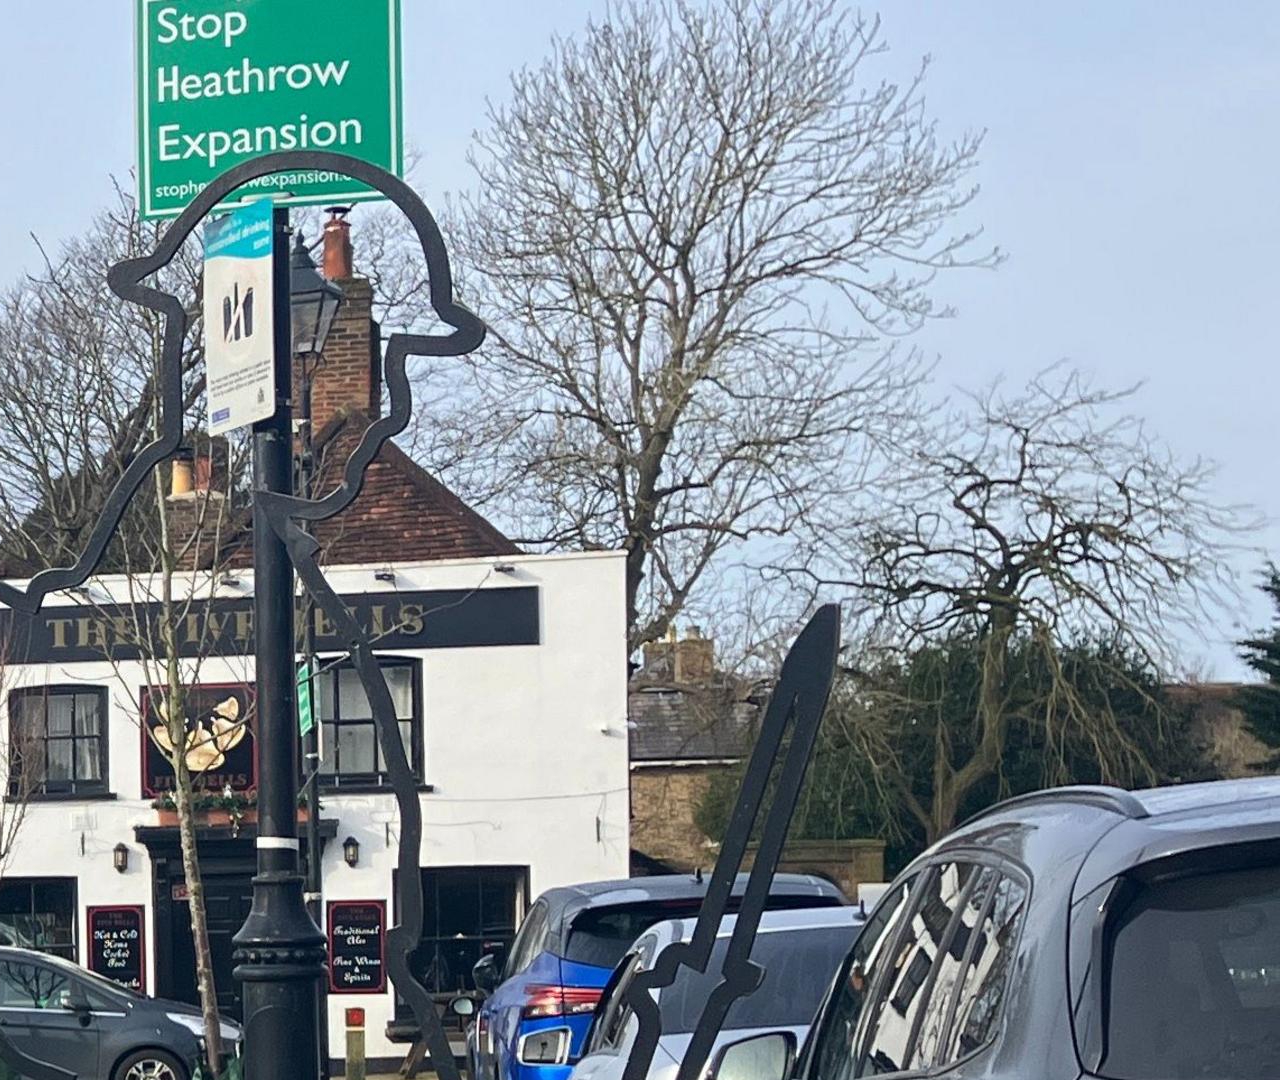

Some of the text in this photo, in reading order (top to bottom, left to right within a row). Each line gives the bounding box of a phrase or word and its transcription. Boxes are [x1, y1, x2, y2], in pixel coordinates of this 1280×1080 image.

[157, 7, 247, 48] Stop
[157, 57, 350, 103] Heathrow
[158, 113, 362, 168] Expansion
[46, 616, 137, 648] THE
